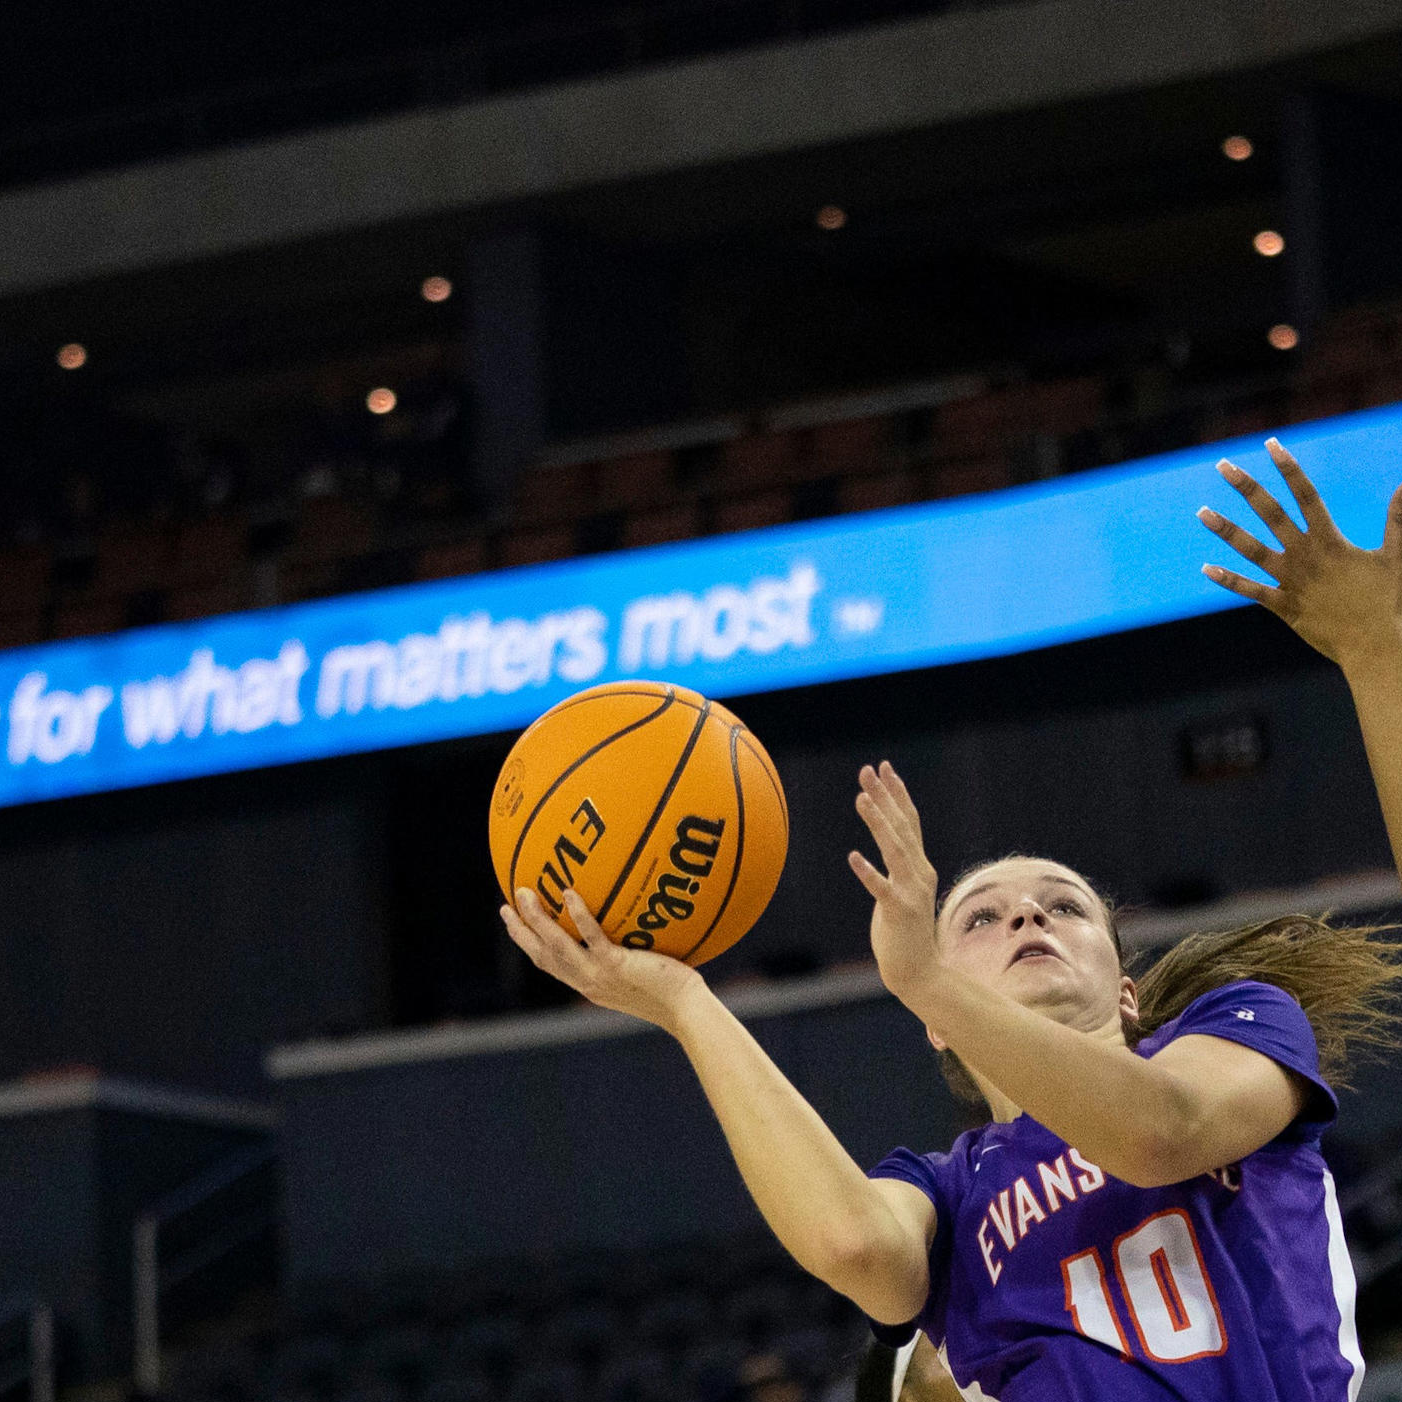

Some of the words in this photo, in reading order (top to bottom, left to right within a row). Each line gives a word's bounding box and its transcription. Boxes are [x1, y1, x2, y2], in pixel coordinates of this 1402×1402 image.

[8, 671, 114, 765] for
[121, 639, 310, 749] what
[315, 609, 607, 719] matters
[619, 562, 817, 673] most
[621, 814, 726, 950] Wilso
[1061, 1208, 1229, 1364] 10
